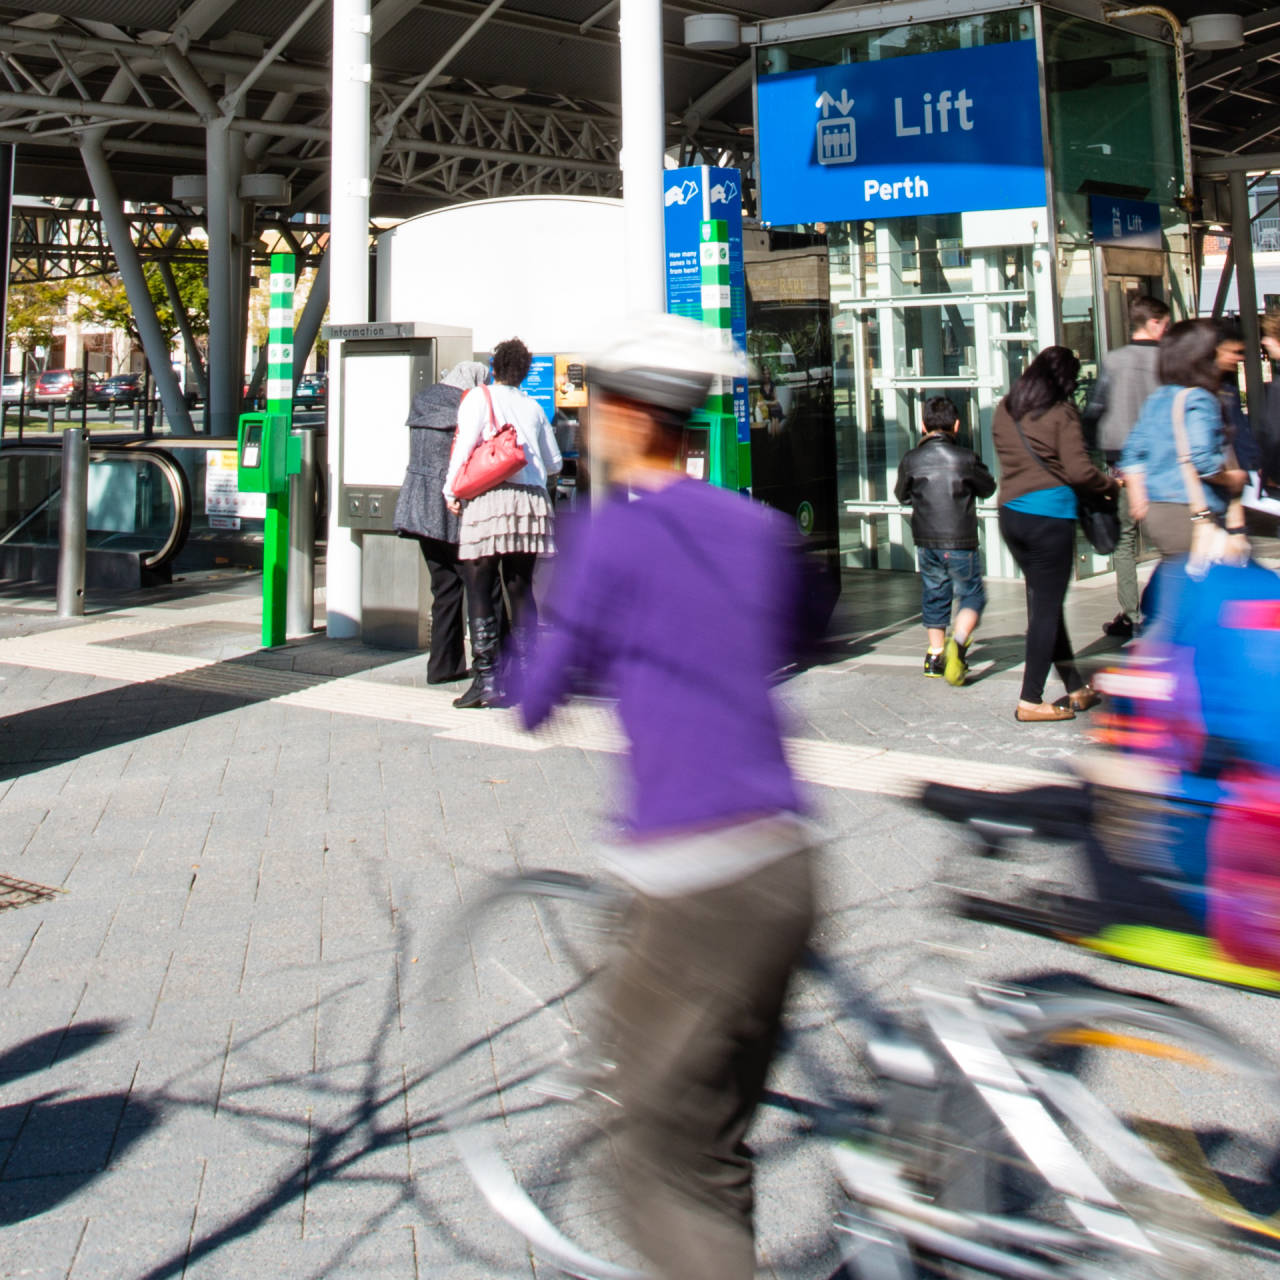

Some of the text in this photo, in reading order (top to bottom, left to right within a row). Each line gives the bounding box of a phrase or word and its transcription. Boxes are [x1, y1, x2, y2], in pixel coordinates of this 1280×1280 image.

[894, 88, 974, 137] Lift
[863, 175, 929, 202] Perth
[330, 326, 384, 337] Information
